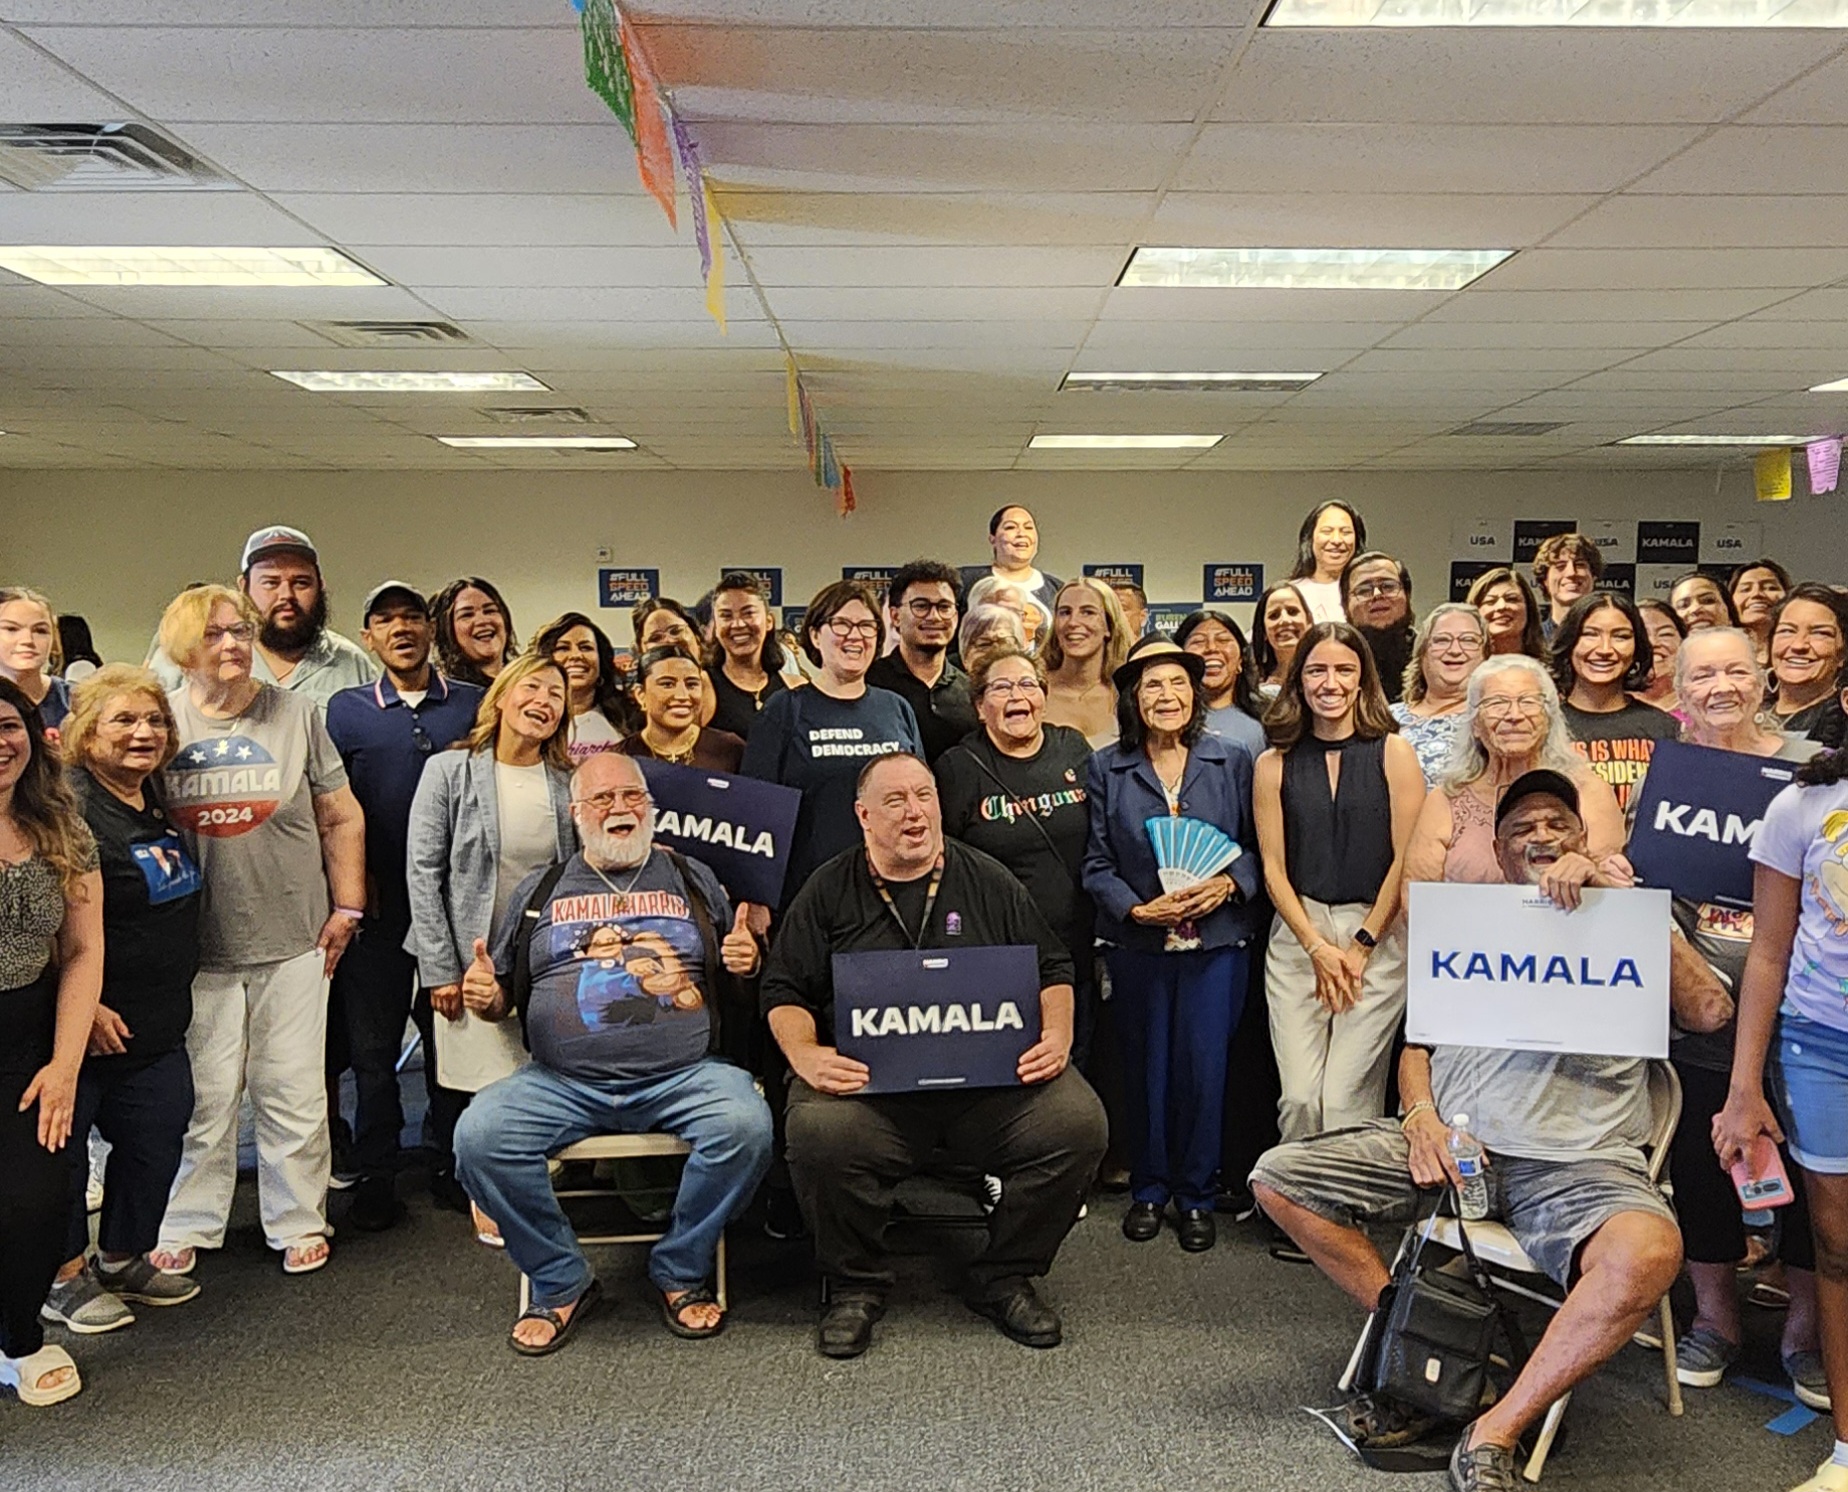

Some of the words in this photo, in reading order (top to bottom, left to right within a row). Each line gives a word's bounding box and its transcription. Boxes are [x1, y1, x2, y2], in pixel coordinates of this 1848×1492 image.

[1470, 537, 1495, 545] USA
[1642, 538, 1693, 547] KAMALA
[1716, 539, 1742, 548] USA
[1094, 568, 1133, 577] #FULL
[1214, 568, 1253, 577] #FULL
[609, 582, 649, 591] SPEED
[1214, 577, 1253, 587] SPEED
[1595, 580, 1630, 588] MALA
[609, 592, 651, 602] AHEAD
[1213, 587, 1253, 597] AHEAD
[808, 728, 863, 741] DEFEND
[811, 741, 900, 758] DEMOCRACY
[1591, 740, 1610, 762] IS
[164, 768, 281, 798] KAMALA
[197, 806, 253, 826] 2024
[1654, 800, 1764, 845] KAM
[1431, 950, 1644, 988] KAMALA
[851, 1001, 1024, 1037] KAMALA
